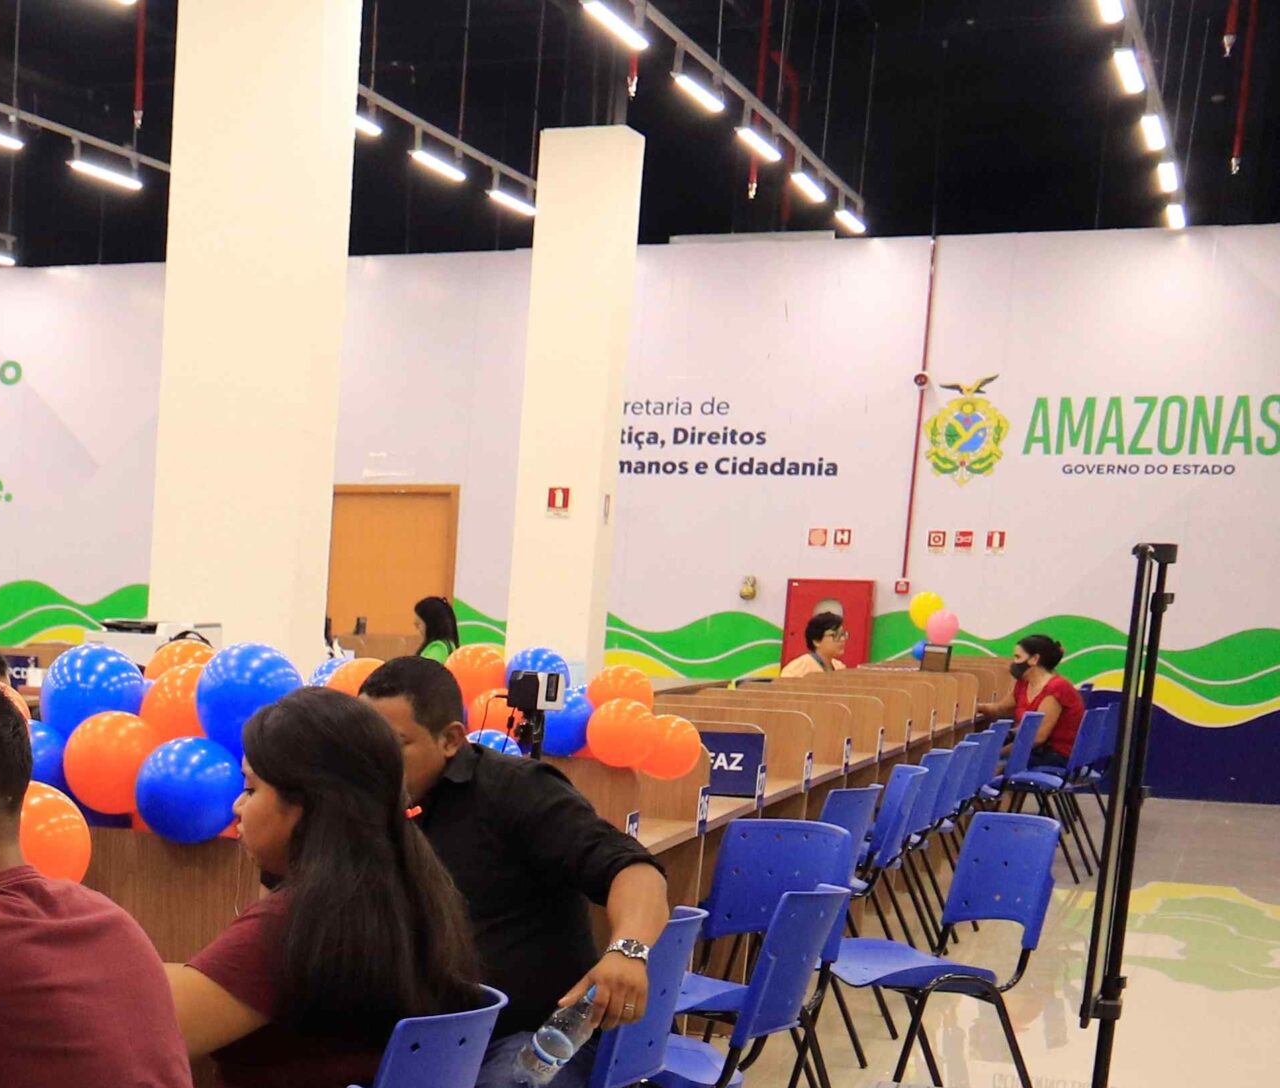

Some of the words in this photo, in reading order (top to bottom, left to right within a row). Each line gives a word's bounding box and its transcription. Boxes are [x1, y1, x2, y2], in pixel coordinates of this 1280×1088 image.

[622, 396, 693, 416] retaria
[700, 396, 730, 416] de
[1022, 393, 1280, 456] AMAZONAS
[620, 425, 666, 451] tiça,
[672, 426, 767, 446] Direitos
[618, 459, 689, 476] manos
[694, 460, 708, 476] e
[715, 456, 839, 477] Cidadania
[1061, 463, 1140, 476] GOVERNO
[1144, 464, 1169, 476] DO
[1172, 463, 1236, 477] ESTADO
